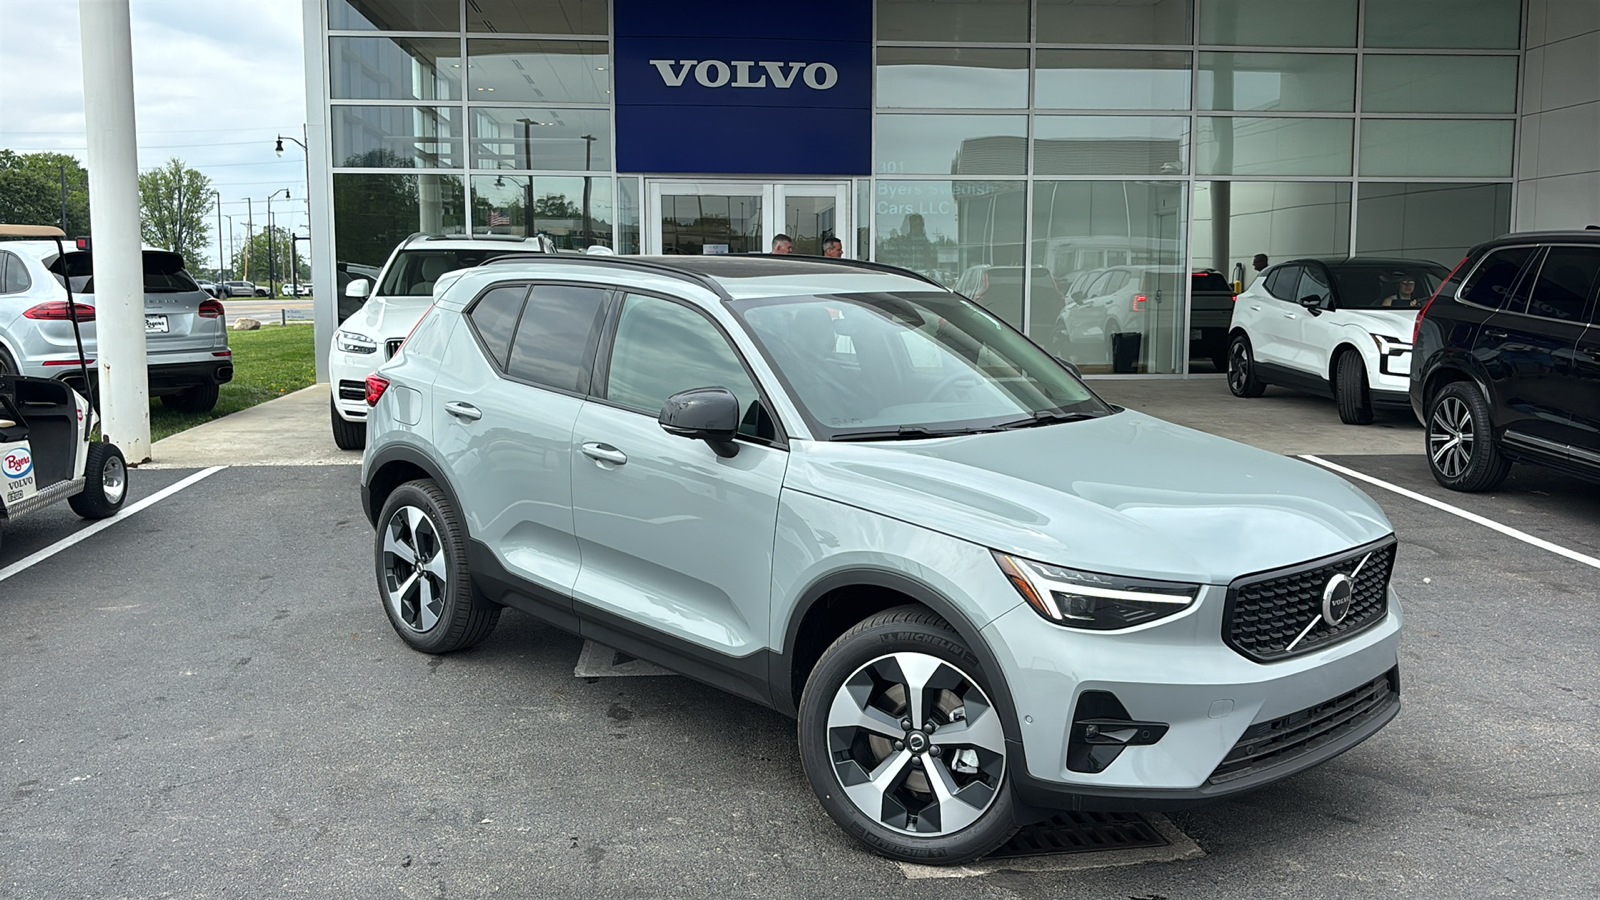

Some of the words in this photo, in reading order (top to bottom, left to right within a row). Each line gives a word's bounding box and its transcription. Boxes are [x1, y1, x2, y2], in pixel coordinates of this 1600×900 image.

[650, 60, 838, 90] VOLVO
[878, 161, 904, 173] 301
[877, 183, 922, 199] Byers
[929, 183, 994, 196] Swedish
[877, 201, 914, 215] Cars
[919, 201, 950, 215] LLC
[5, 455, 30, 472] Byers
[8, 476, 34, 490] VOLVO
[897, 632, 964, 656] MICHELIN
